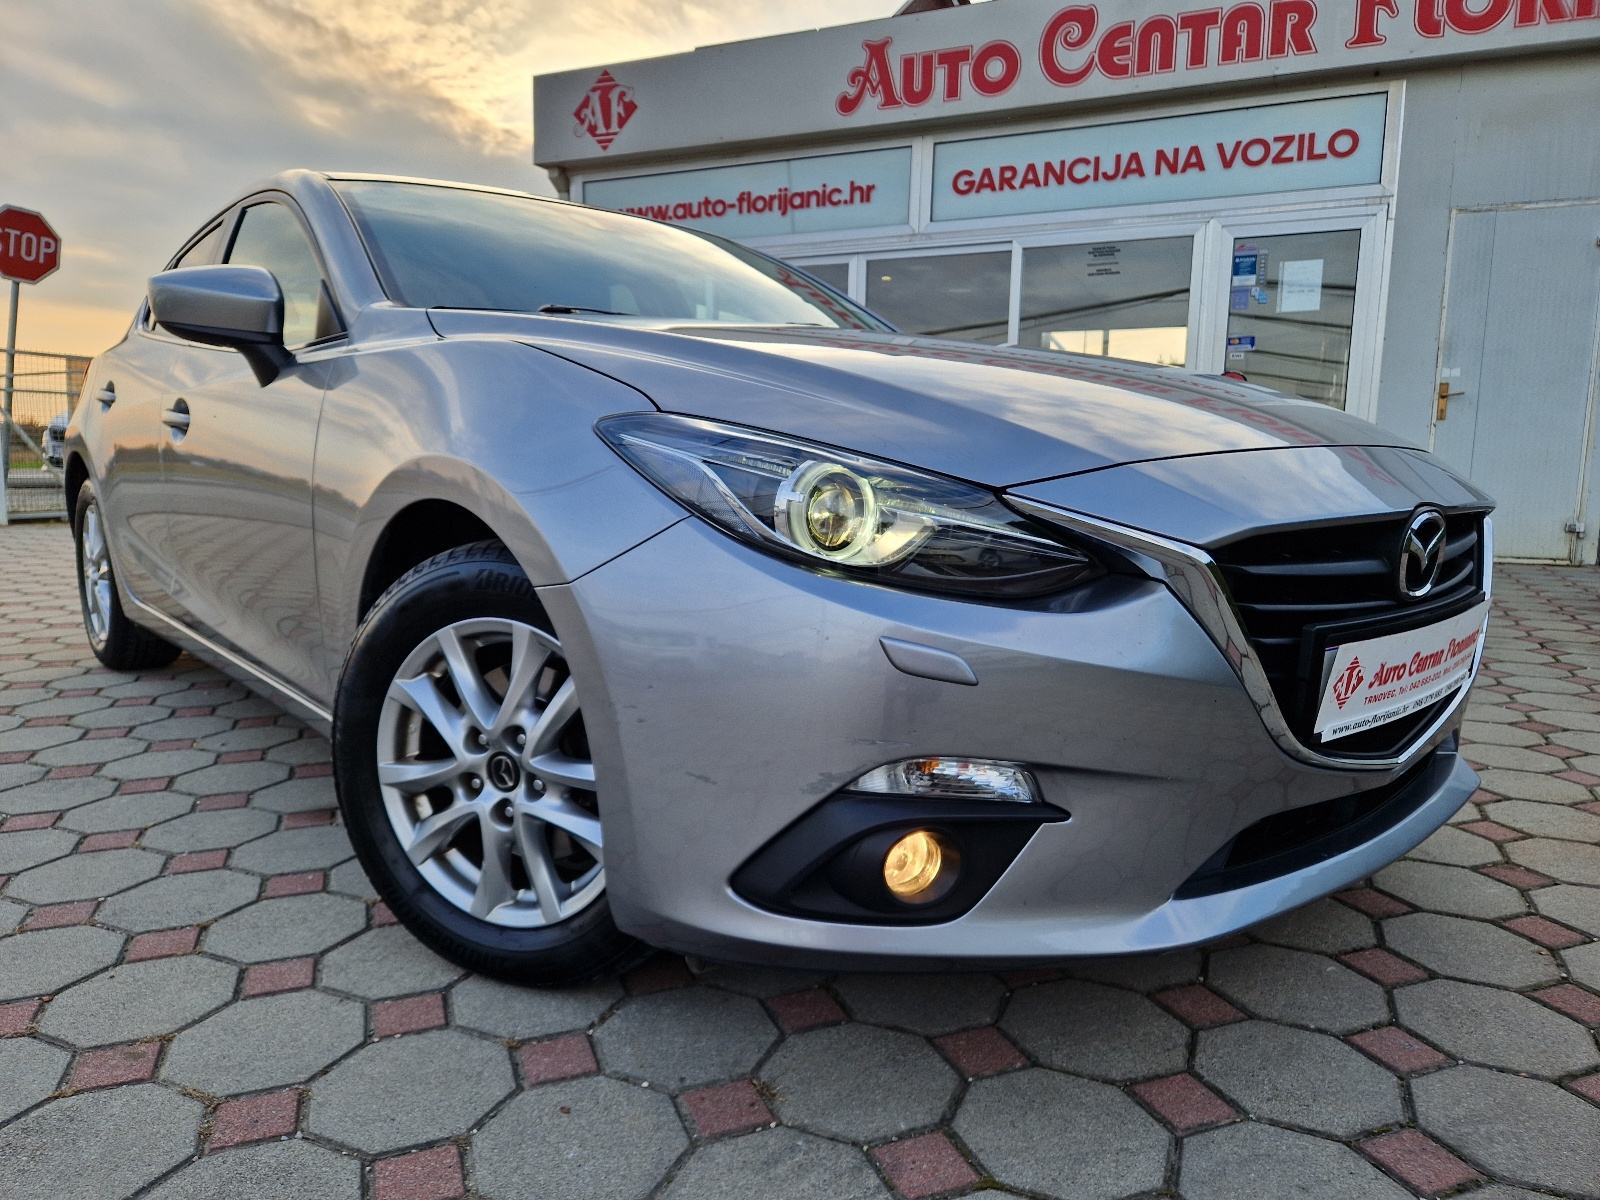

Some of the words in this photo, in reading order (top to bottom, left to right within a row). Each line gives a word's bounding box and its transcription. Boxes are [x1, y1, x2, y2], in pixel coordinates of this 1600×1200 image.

[951, 152, 1145, 196] GARANCIJA
[1154, 145, 1206, 175] NA
[1215, 128, 1360, 170] VOZILO
[618, 180, 876, 221] ww.auto-florijanic.hr
[0, 227, 56, 264] TOP
[1368, 661, 1407, 689] AUTO
